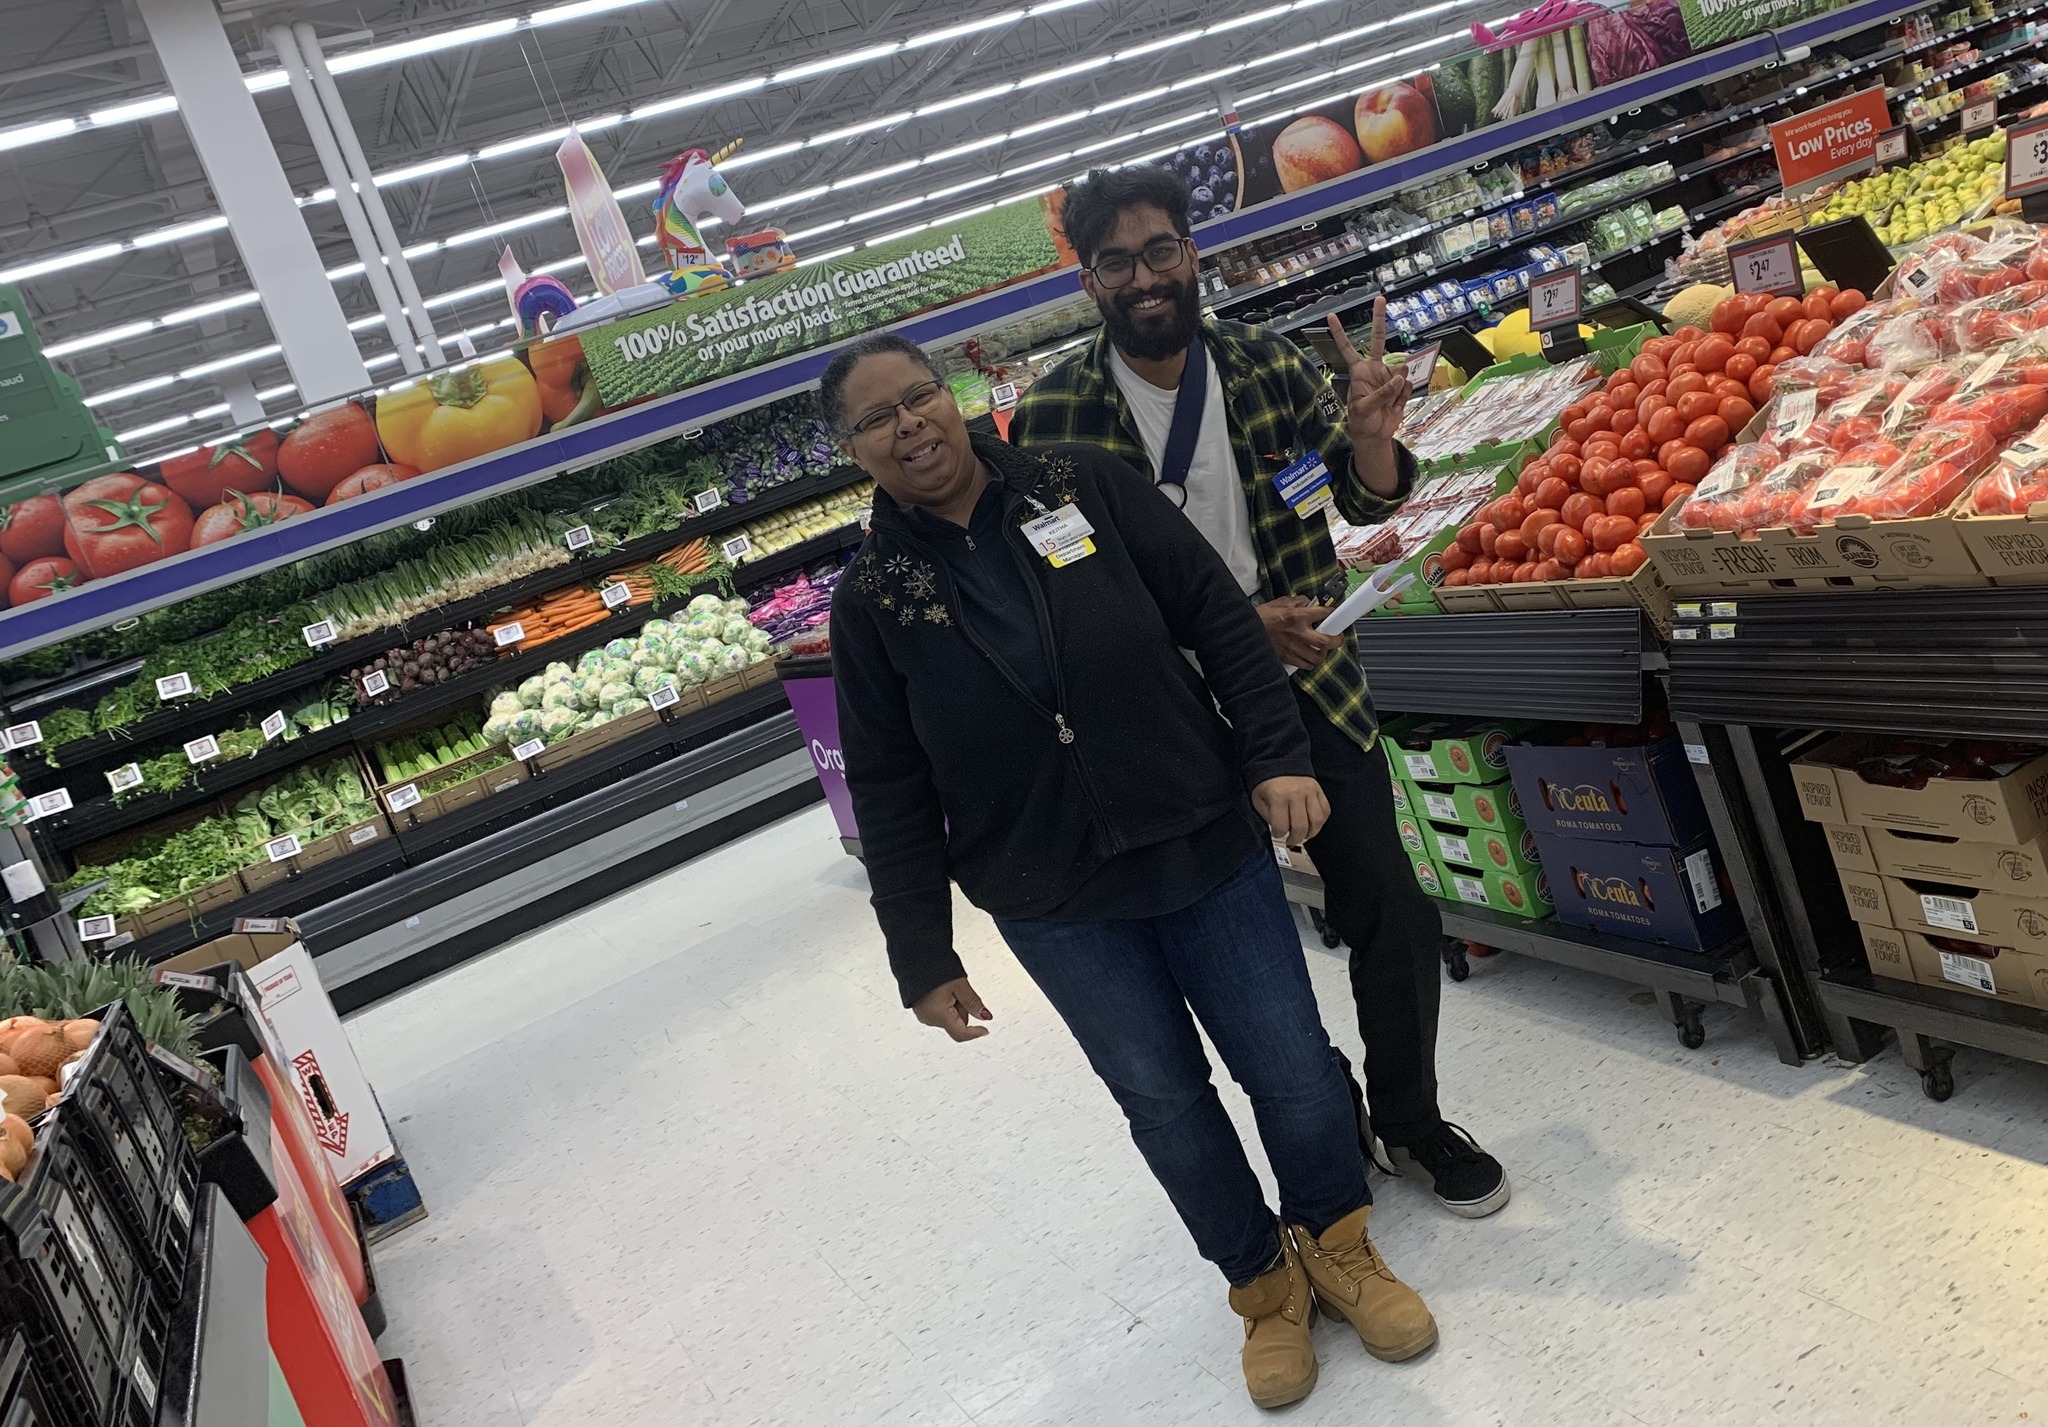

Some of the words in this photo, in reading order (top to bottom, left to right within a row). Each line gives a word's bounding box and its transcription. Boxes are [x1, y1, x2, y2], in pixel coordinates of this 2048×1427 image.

[1742, 9, 1753, 20] or
[1752, 4, 1772, 20] your
[1785, 129, 1795, 137] We
[1795, 123, 1808, 134] work
[1808, 118, 1821, 129] hard
[1821, 115, 1827, 124] to
[1827, 111, 1842, 122] bring
[1842, 108, 1853, 119] you
[1788, 135, 1823, 161] Low
[1824, 117, 1872, 147] Prices
[1830, 142, 1856, 160] Every
[1856, 135, 1873, 150] day
[613, 321, 687, 363] 100%
[686, 281, 835, 342] Satisfaction
[833, 234, 966, 297] Guaranteed
[856, 302, 885, 315] Customer
[885, 293, 906, 306] Service
[906, 288, 921, 299] desk
[920, 284, 930, 294] for
[868, 286, 901, 301] Conditions
[698, 343, 714, 362] or
[713, 333, 750, 359] your
[751, 319, 801, 346] money
[801, 305, 842, 330] back.
[1280, 464, 1309, 485] Walmart
[1032, 515, 1060, 531] Walmart
[1048, 523, 1068, 535] KEITHA
[1039, 538, 1056, 552] 15
[1983, 534, 2045, 551] INSPIRED
[1055, 544, 1086, 559] Department
[1062, 551, 1085, 563] Manager
[1660, 548, 1700, 563] INSPIRED
[1842, 551, 1881, 562] SUNSET
[1714, 545, 1775, 575] FRESH
[1786, 547, 1828, 566] FROM
[1427, 566, 1443, 586] SUNS
[1670, 562, 1709, 576] FLAVOR
[1485, 748, 1505, 765] SUN
[1801, 781, 1831, 795] INSPIRED
[1560, 785, 1611, 812] Ceuta
[1805, 794, 1832, 808] FLAVOR
[1556, 819, 1578, 829] ROMA
[1579, 821, 1623, 832] TOMATOES
[1402, 834, 1421, 845] SUNSET
[1831, 829, 1861, 844] INSPIRED
[1836, 842, 1863, 856] FLAVOR
[1419, 875, 1438, 887] SUNSET
[1592, 879, 1640, 907] Ceuta
[1848, 884, 1879, 899] INSPIRED
[1853, 897, 1880, 910] FLAVOR
[1588, 906, 1609, 918] ROMA
[1609, 911, 1651, 926] TOMATOES
[1869, 938, 1901, 952] INSPIRED
[1874, 950, 1902, 965] FLAVOR
